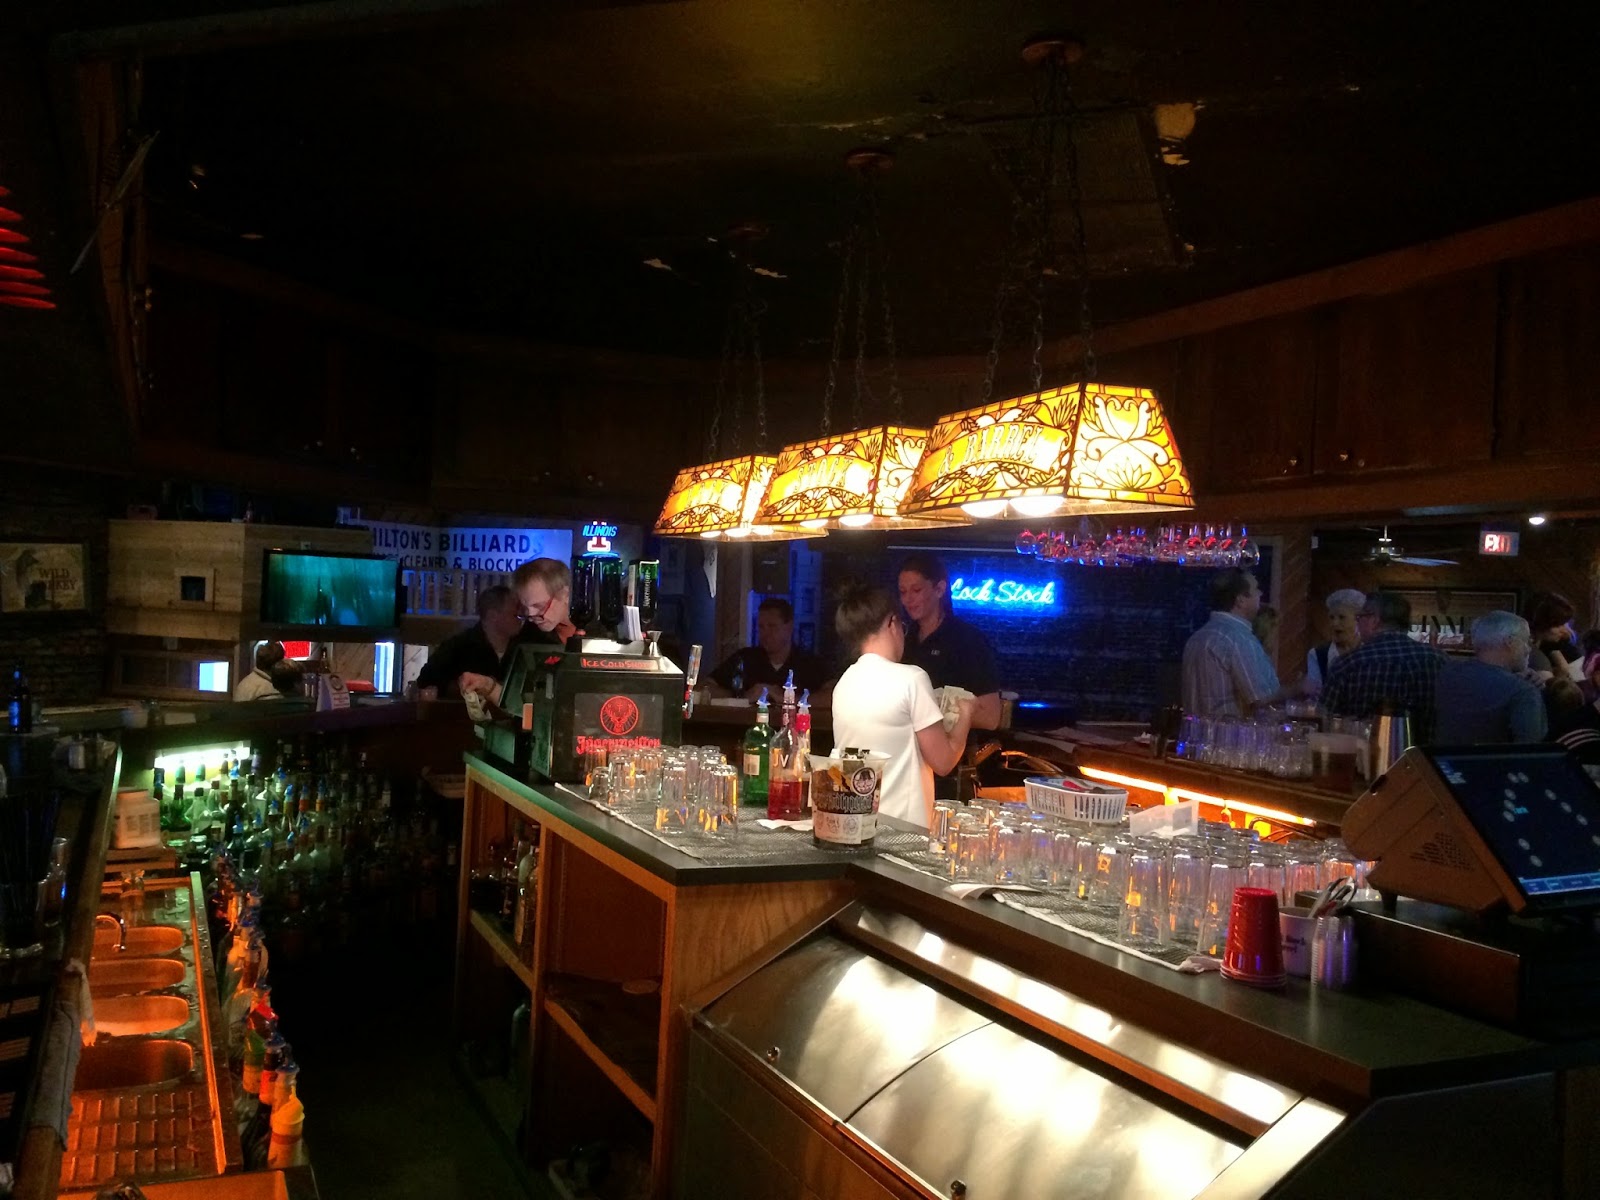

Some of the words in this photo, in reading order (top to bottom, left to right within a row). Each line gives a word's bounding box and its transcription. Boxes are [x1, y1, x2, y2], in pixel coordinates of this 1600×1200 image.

[962, 424, 1044, 466] BARREL
[582, 525, 617, 537] ILLINOIS
[439, 533, 545, 554] BILLIARDS
[469, 558, 528, 572] BLOCKE
[995, 580, 1055, 604] Stock
[582, 658, 599, 668] ICE
